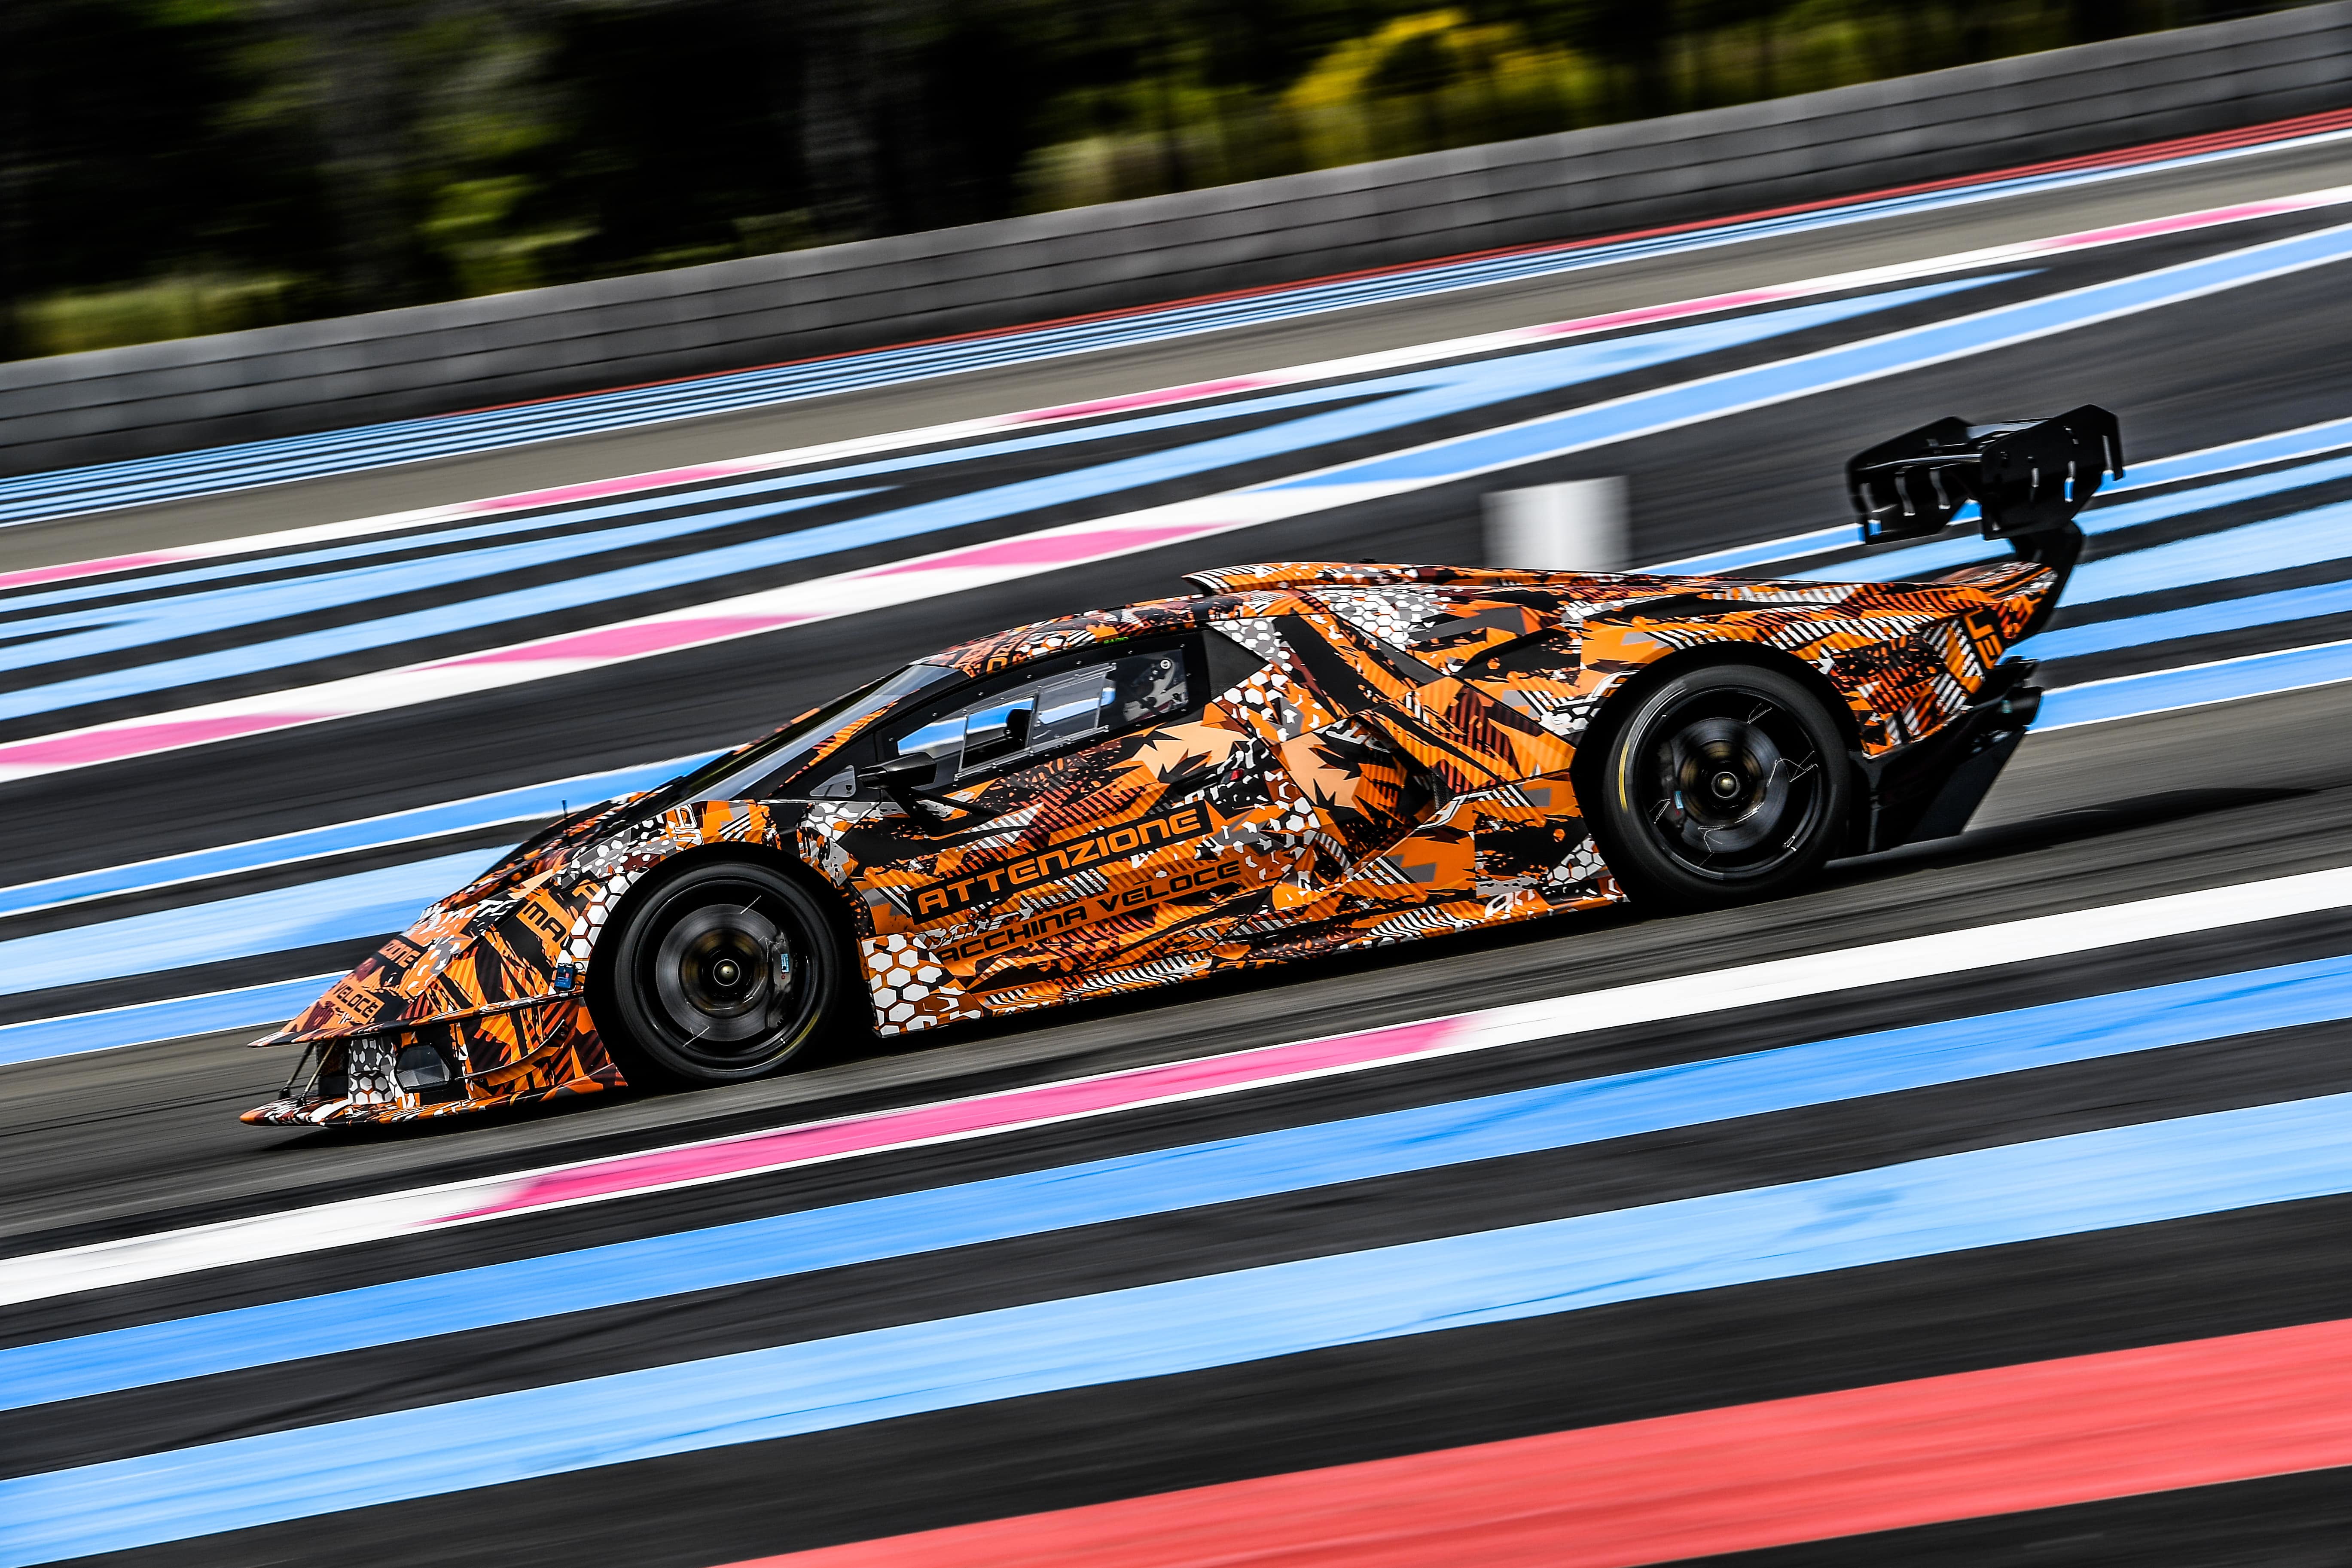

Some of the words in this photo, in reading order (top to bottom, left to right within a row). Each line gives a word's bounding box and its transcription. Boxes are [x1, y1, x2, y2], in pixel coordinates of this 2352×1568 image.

[918, 808, 1201, 915] ATTENZIONE
[937, 906, 1087, 962] ACCHINA
[1096, 860, 1241, 912] VELOCE
[332, 982, 379, 1019] VELOCE
